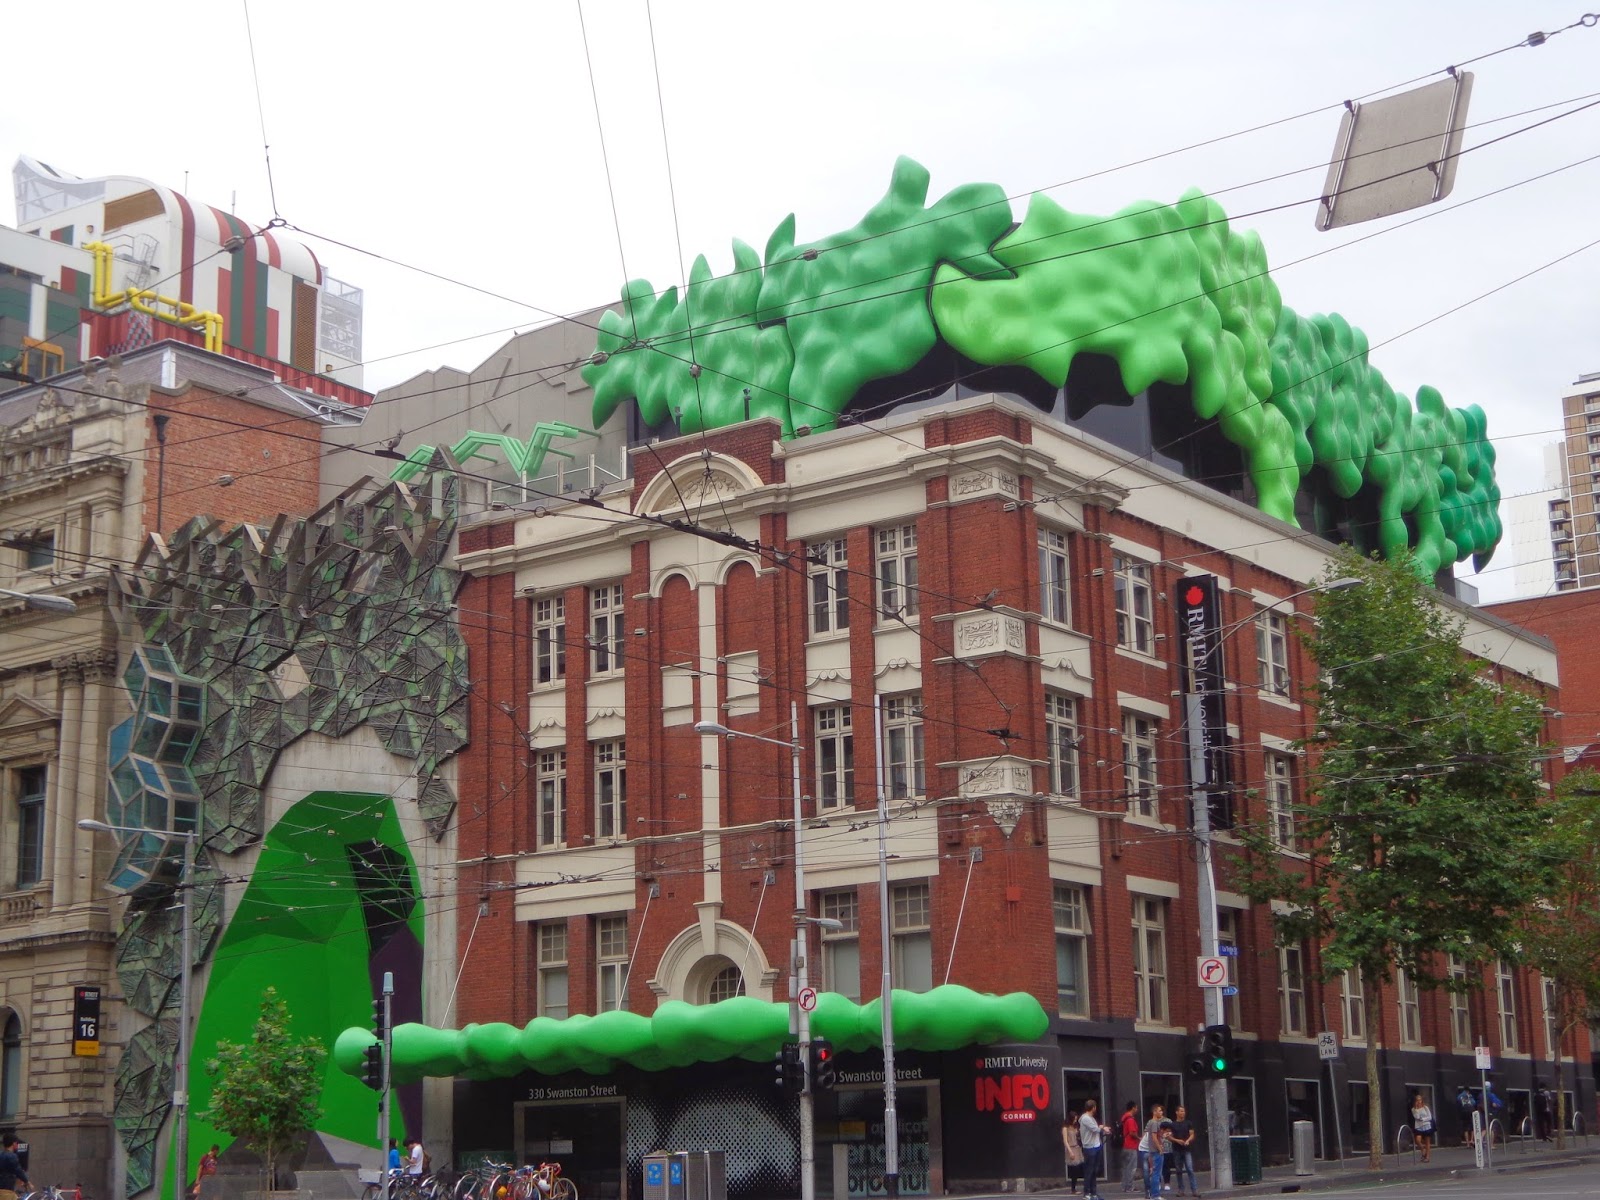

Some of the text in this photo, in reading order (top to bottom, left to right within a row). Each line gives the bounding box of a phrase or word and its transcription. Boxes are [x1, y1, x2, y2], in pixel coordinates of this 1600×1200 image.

[1188, 606, 1207, 665] RMIT
[81, 1024, 96, 1037] 16
[984, 1056, 1013, 1068] RMIT
[528, 1084, 617, 1099] 330 Swanston Street
[975, 1074, 1050, 1111] INFO
[1003, 1112, 1034, 1120] CORNER
